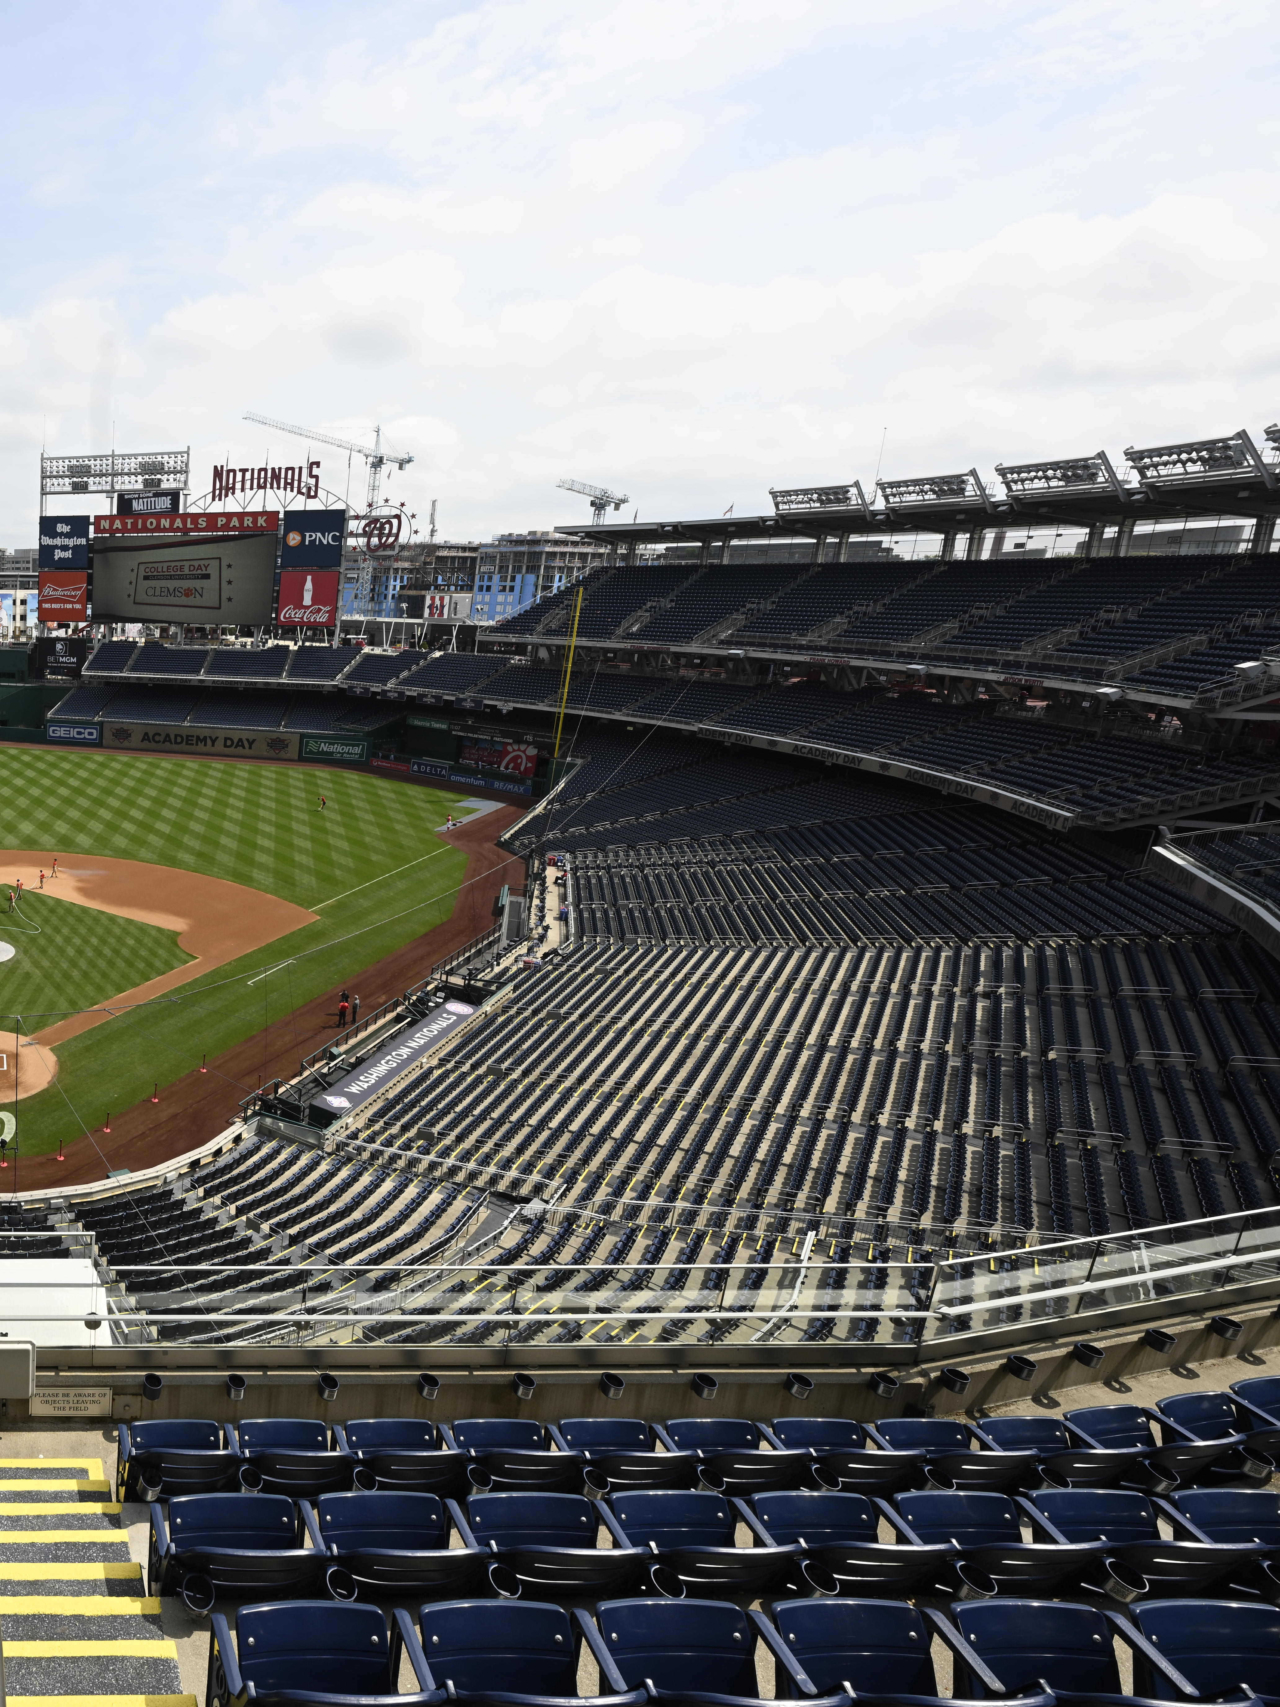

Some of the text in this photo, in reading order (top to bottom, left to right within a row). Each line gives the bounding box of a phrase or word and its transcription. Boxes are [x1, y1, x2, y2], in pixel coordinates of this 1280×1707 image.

[211, 460, 321, 502] NATIONALS
[131, 496, 173, 511] NATITUDE
[56, 523, 71, 534] The
[100, 516, 268, 530] NATIONALS PARK
[40, 535, 86, 548] Washington
[304, 532, 340, 545] PNC
[54, 549, 72, 560] Post
[144, 564, 210, 574] COLLEGE DAY
[43, 587, 81, 596] Budweiser
[280, 604, 332, 622] Coca-Cola
[49, 726, 97, 740] GEICO
[735, 734, 754, 744] DAY
[140, 732, 256, 750] ACADEMY DAY
[792, 744, 864, 768] ACADEMY DAY
[420, 765, 446, 776] DELTA
[451, 776, 485, 786] amentum
[494, 782, 525, 793] RE/MAX
[905, 770, 977, 798] ACADEMY DAY
[1010, 801, 1062, 827] ACADEMY
[344, 1013, 458, 1094] WASHINGTON NATIONALS
